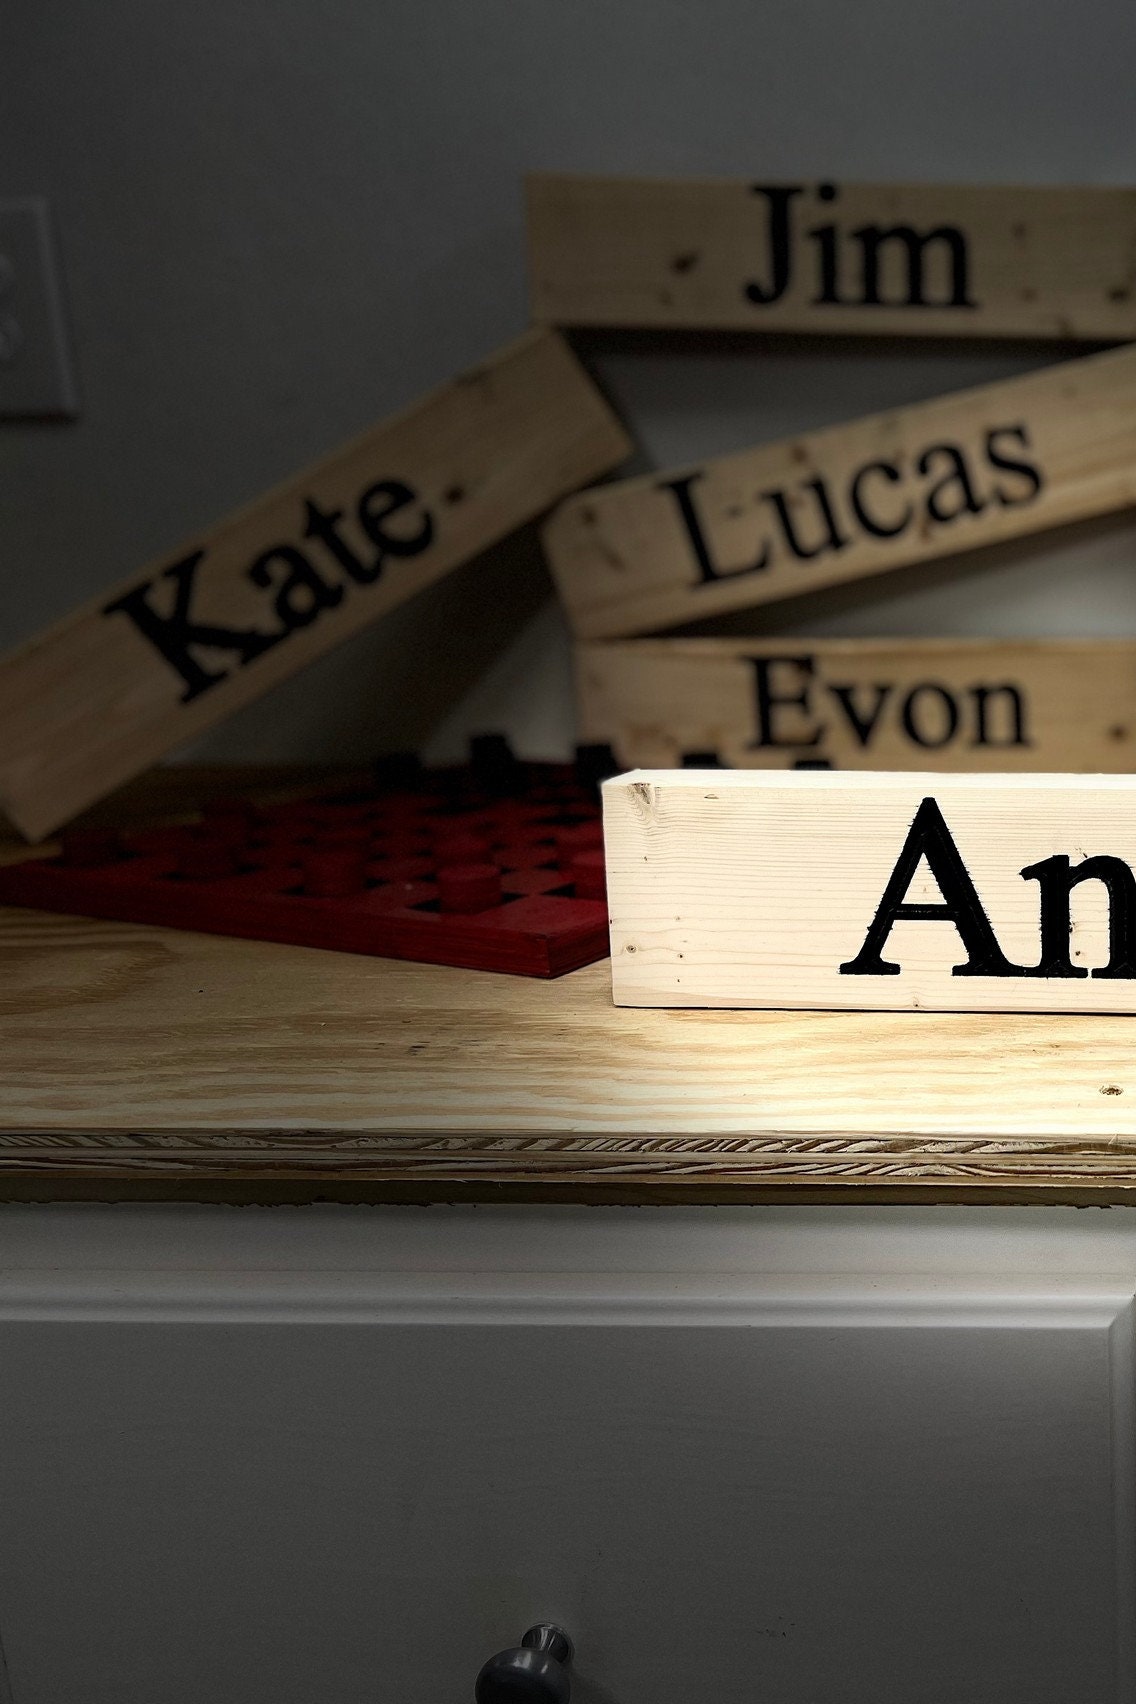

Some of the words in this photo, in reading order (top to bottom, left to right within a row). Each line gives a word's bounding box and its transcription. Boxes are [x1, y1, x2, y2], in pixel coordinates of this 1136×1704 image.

[743, 184, 976, 309] Jim
[662, 423, 1043, 588] Lucas
[105, 478, 435, 703] Kate
[745, 655, 1031, 751] Evon
